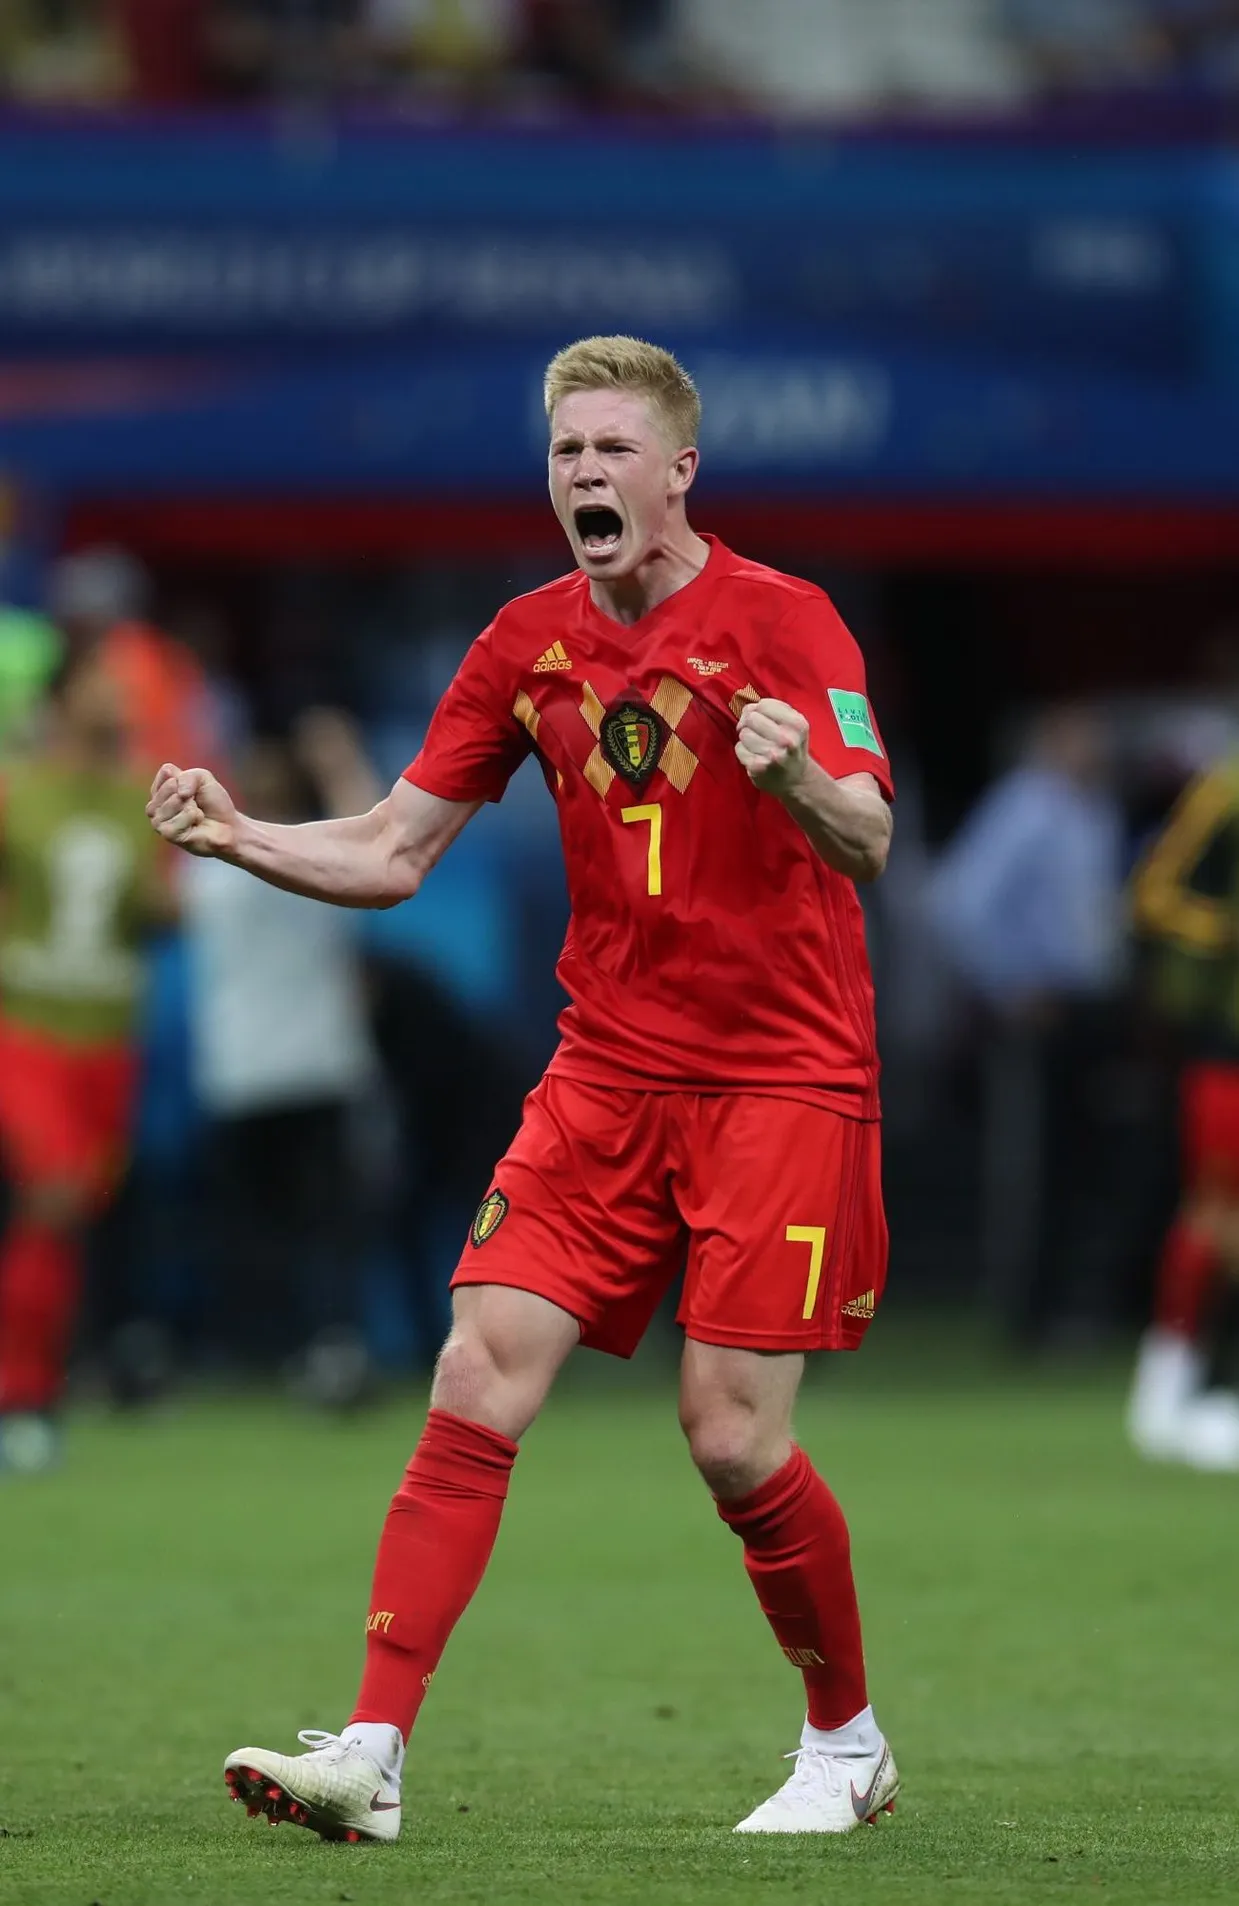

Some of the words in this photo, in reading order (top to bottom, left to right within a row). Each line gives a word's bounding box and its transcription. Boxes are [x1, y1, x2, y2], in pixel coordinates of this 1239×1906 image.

[533, 660, 573, 673] adidas
[620, 803, 662, 896] 7
[785, 1224, 827, 1320] 7
[841, 1304, 875, 1319] adidas
